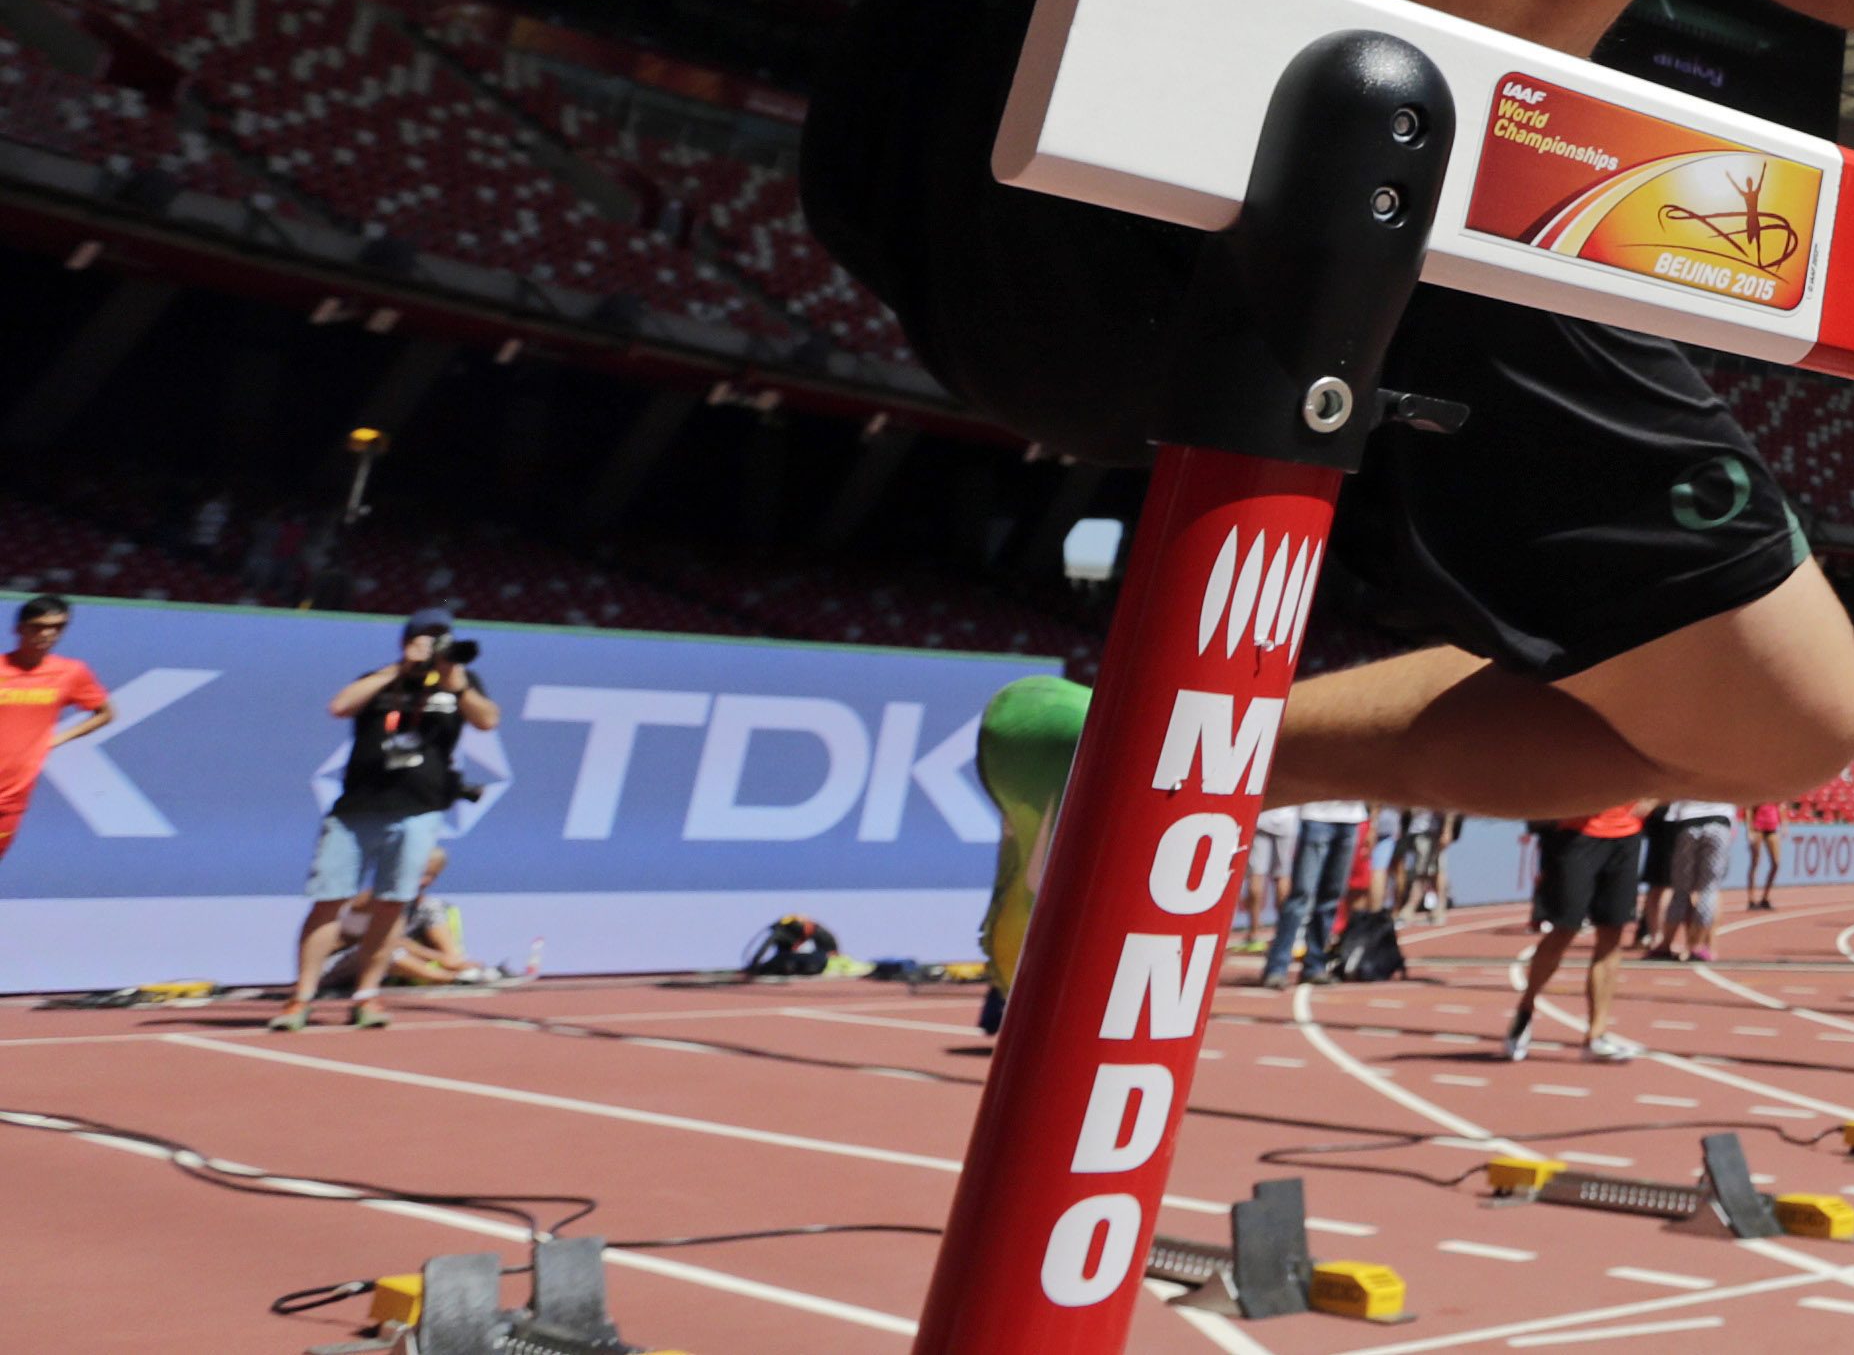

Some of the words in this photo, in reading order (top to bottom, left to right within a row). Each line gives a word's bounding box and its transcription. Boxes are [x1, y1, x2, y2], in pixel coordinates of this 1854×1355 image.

[1497, 98, 1550, 129] World
[1502, 81, 1547, 105] IAAF
[1493, 118, 1619, 171] Championships
[1654, 252, 1732, 290] BEIJING
[1731, 273, 1776, 301] 2015
[522, 684, 1003, 844] TDK
[1040, 689, 1285, 1308] MONDO
